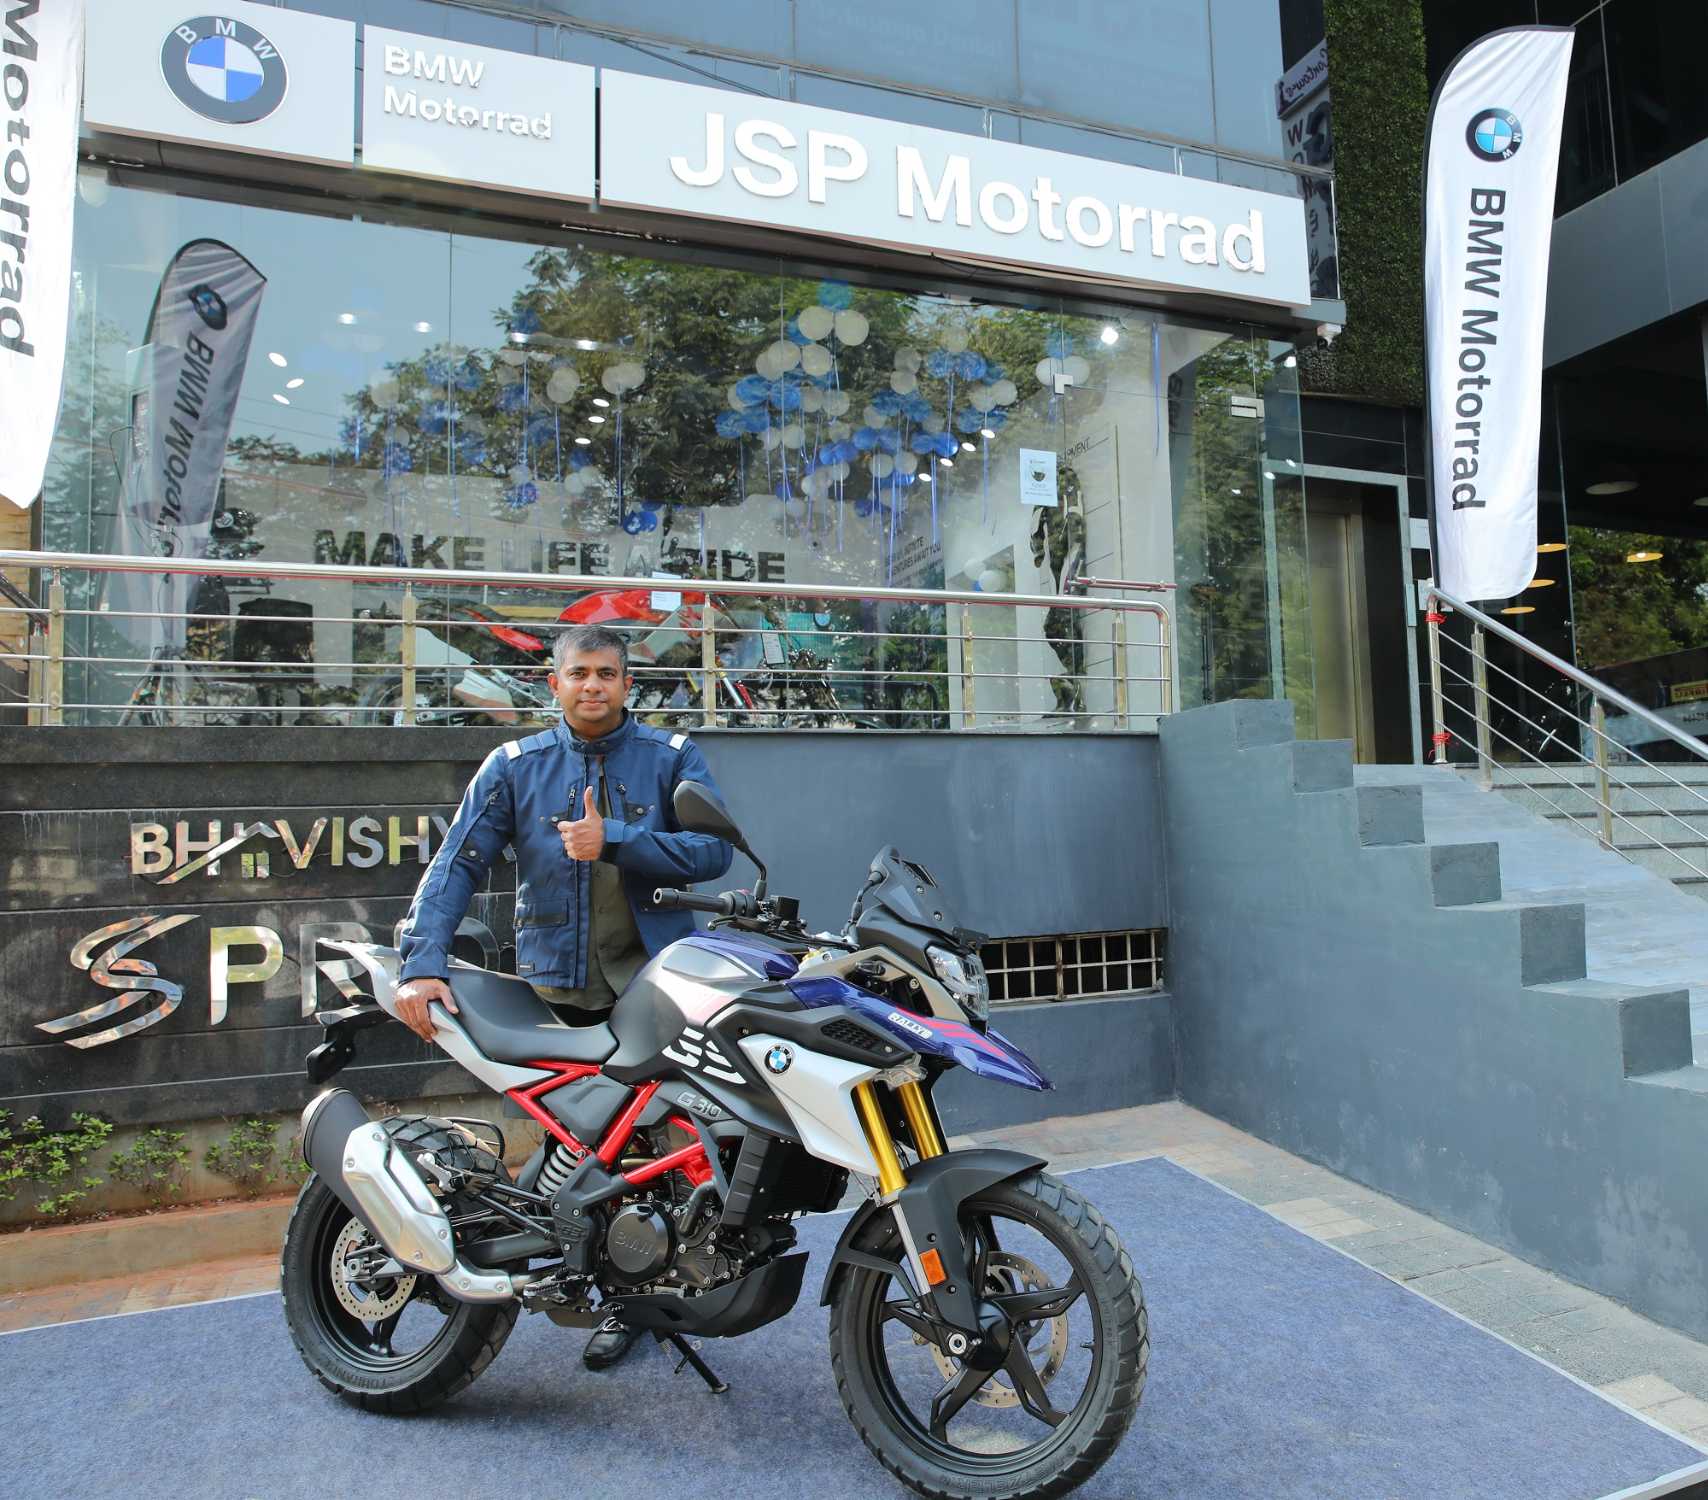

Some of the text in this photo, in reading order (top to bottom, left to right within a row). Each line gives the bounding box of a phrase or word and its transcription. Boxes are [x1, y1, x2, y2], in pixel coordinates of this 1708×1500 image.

[175, 18, 278, 60] BMW
[384, 45, 485, 88] BMW
[384, 85, 552, 139] Motorrad
[0, 0, 40, 357] Motorrad
[669, 112, 868, 203] JSP
[896, 145, 1266, 274] Motorrad
[1452, 188, 1506, 511] BMW Motorrad
[314, 529, 485, 570] MAKE
[130, 815, 517, 885] BHAVISH
[677, 1091, 722, 1119] G 310
